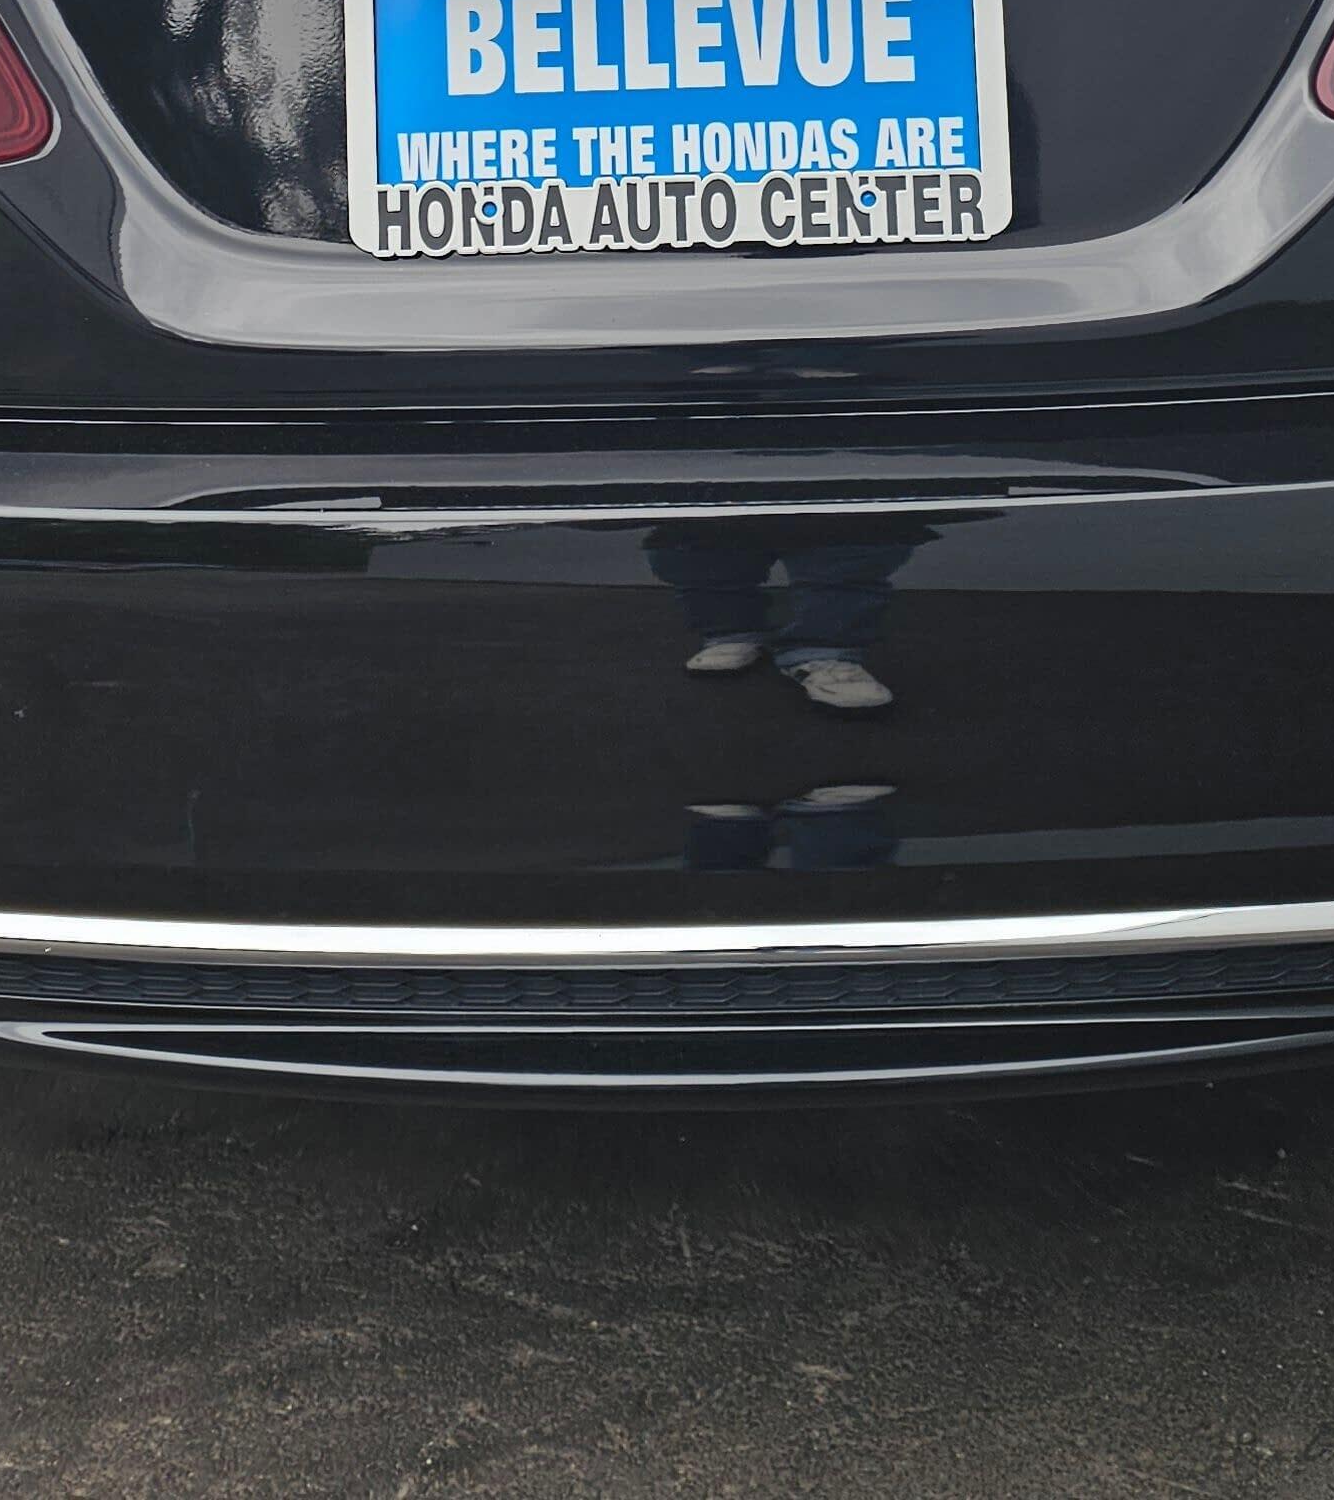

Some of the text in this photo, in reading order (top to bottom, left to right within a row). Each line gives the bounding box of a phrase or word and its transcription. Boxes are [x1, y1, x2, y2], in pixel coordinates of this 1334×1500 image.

[396, 116, 966, 182] WHERE THE HONDAS ARE
[377, 174, 984, 251] HONDA AUTO CENTER
